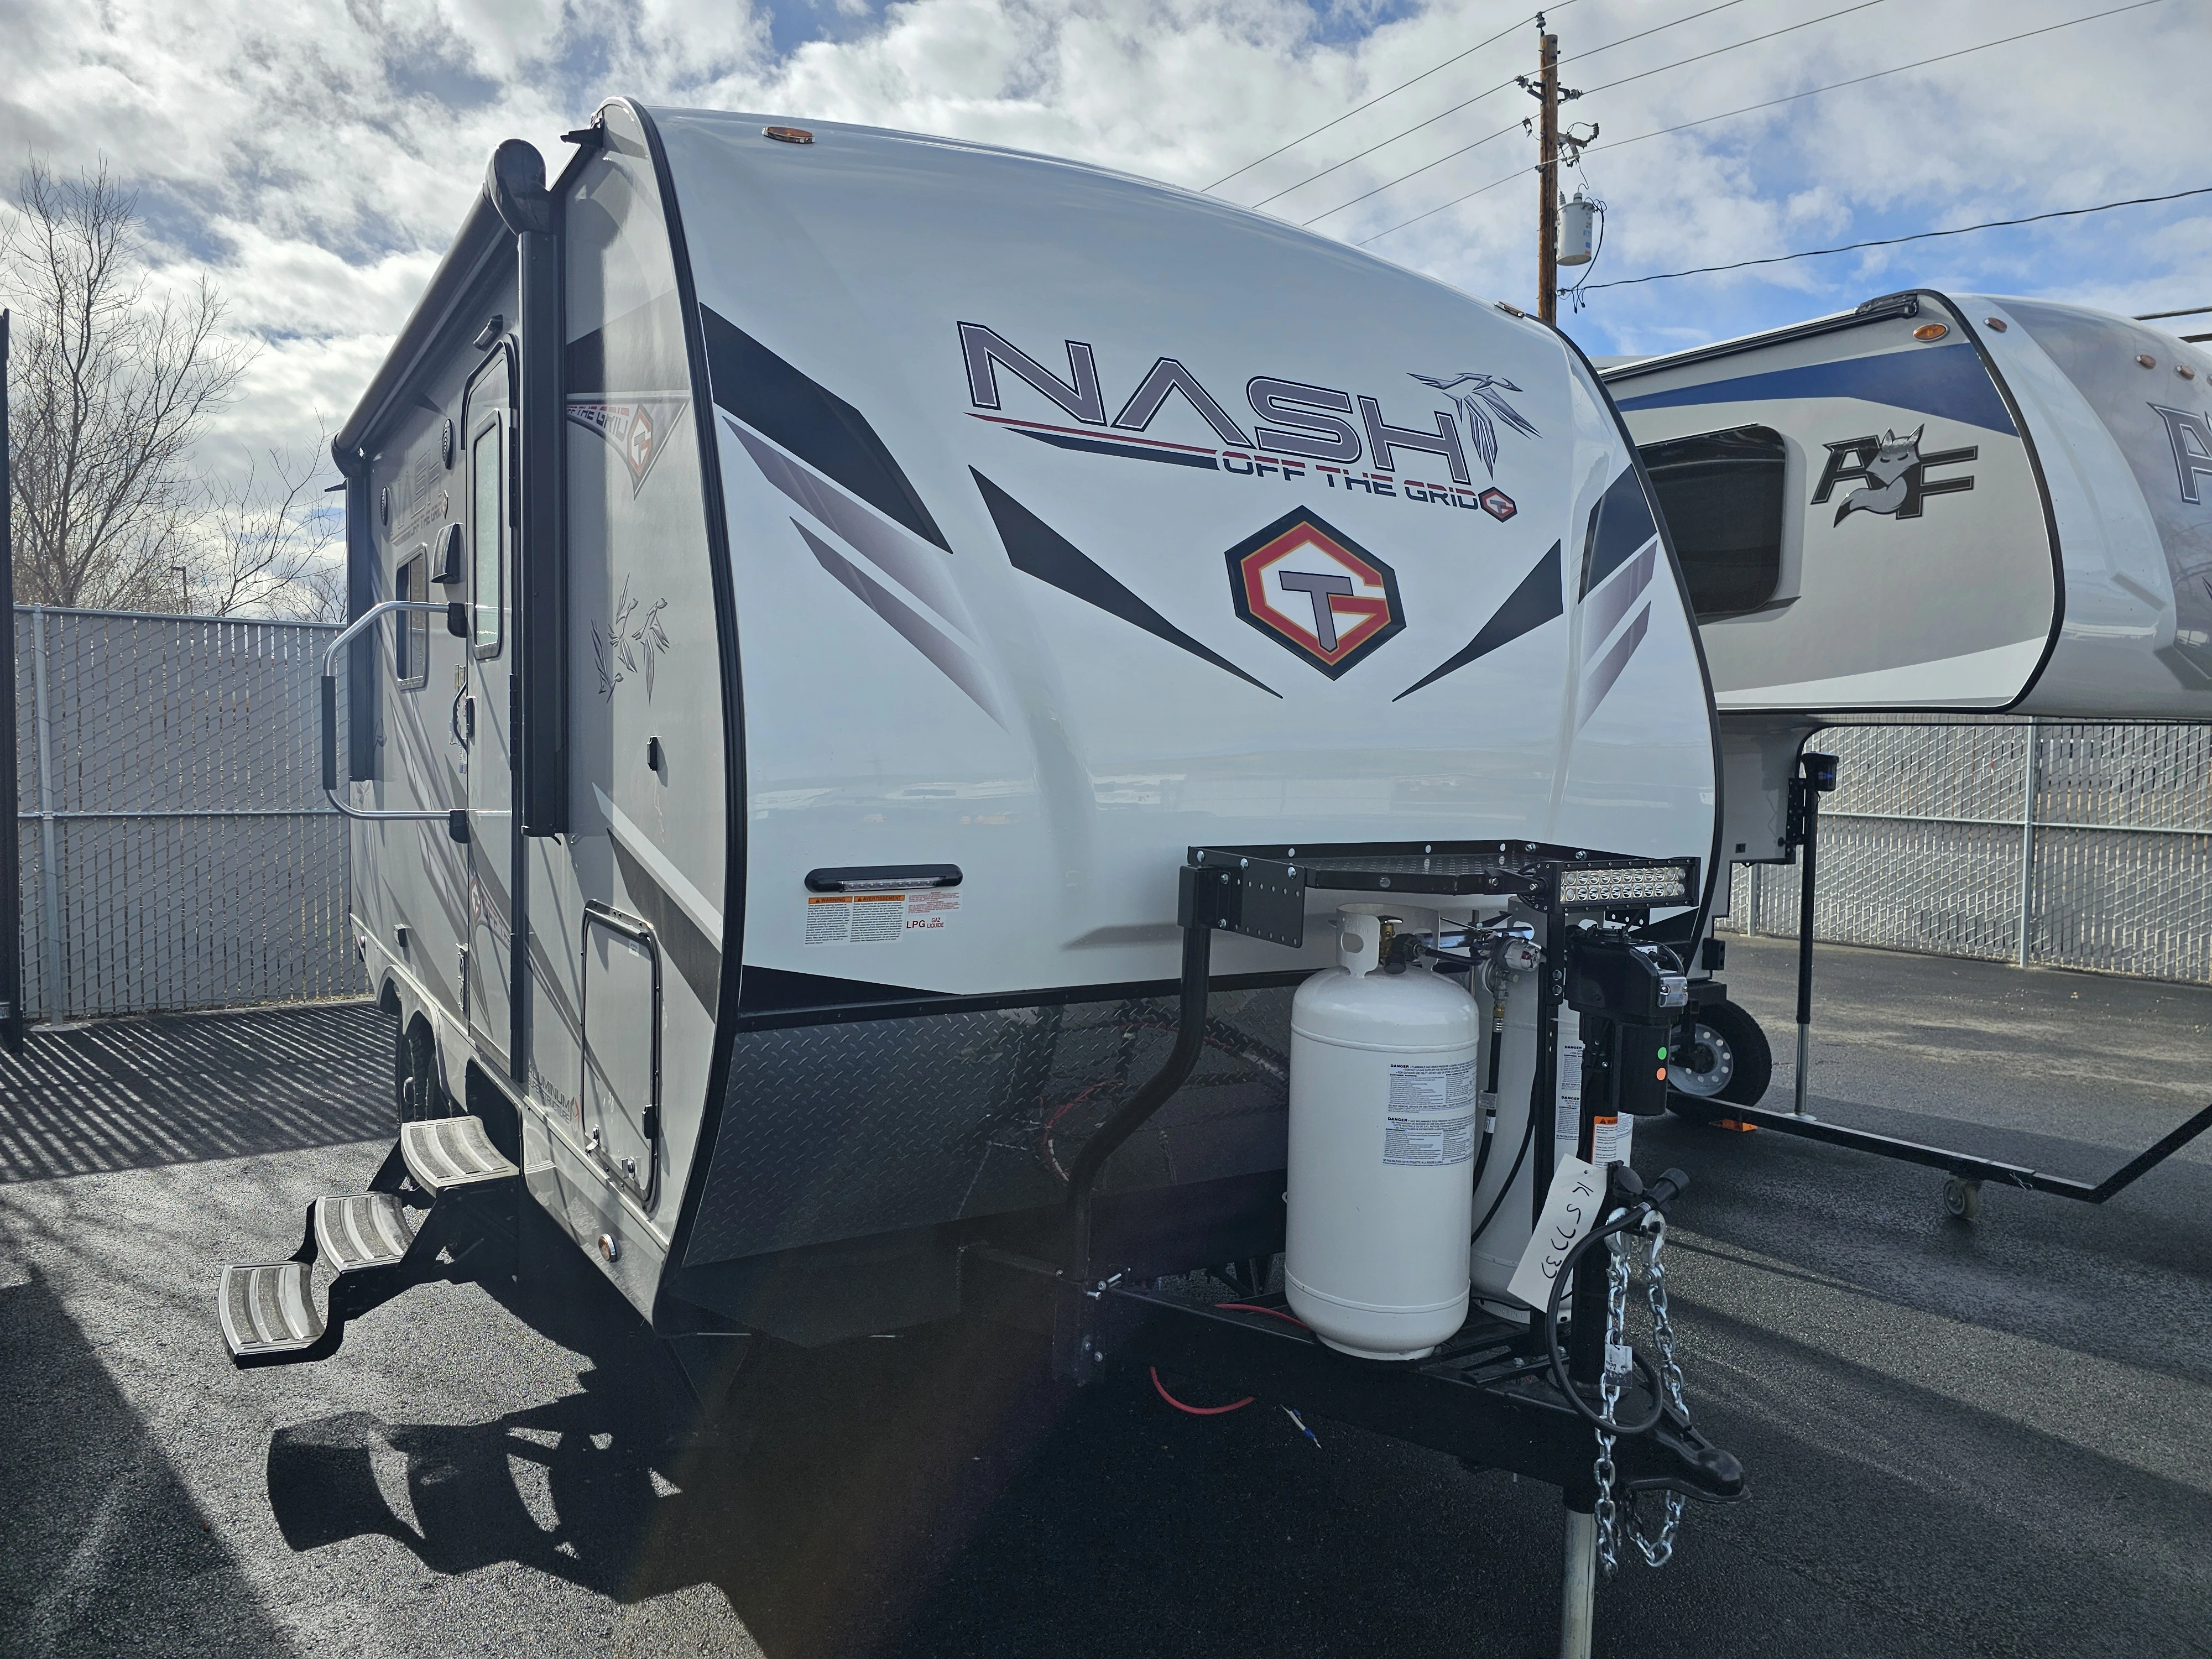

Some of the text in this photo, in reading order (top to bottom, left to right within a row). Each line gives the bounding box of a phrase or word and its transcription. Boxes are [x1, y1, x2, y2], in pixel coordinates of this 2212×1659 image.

[596, 406, 630, 442] GRID
[957, 320, 1472, 486] NASH
[1222, 450, 1306, 481] OFF
[1316, 465, 1397, 498] THE
[1404, 479, 1479, 510] GRID
[906, 920, 925, 928] LPG
